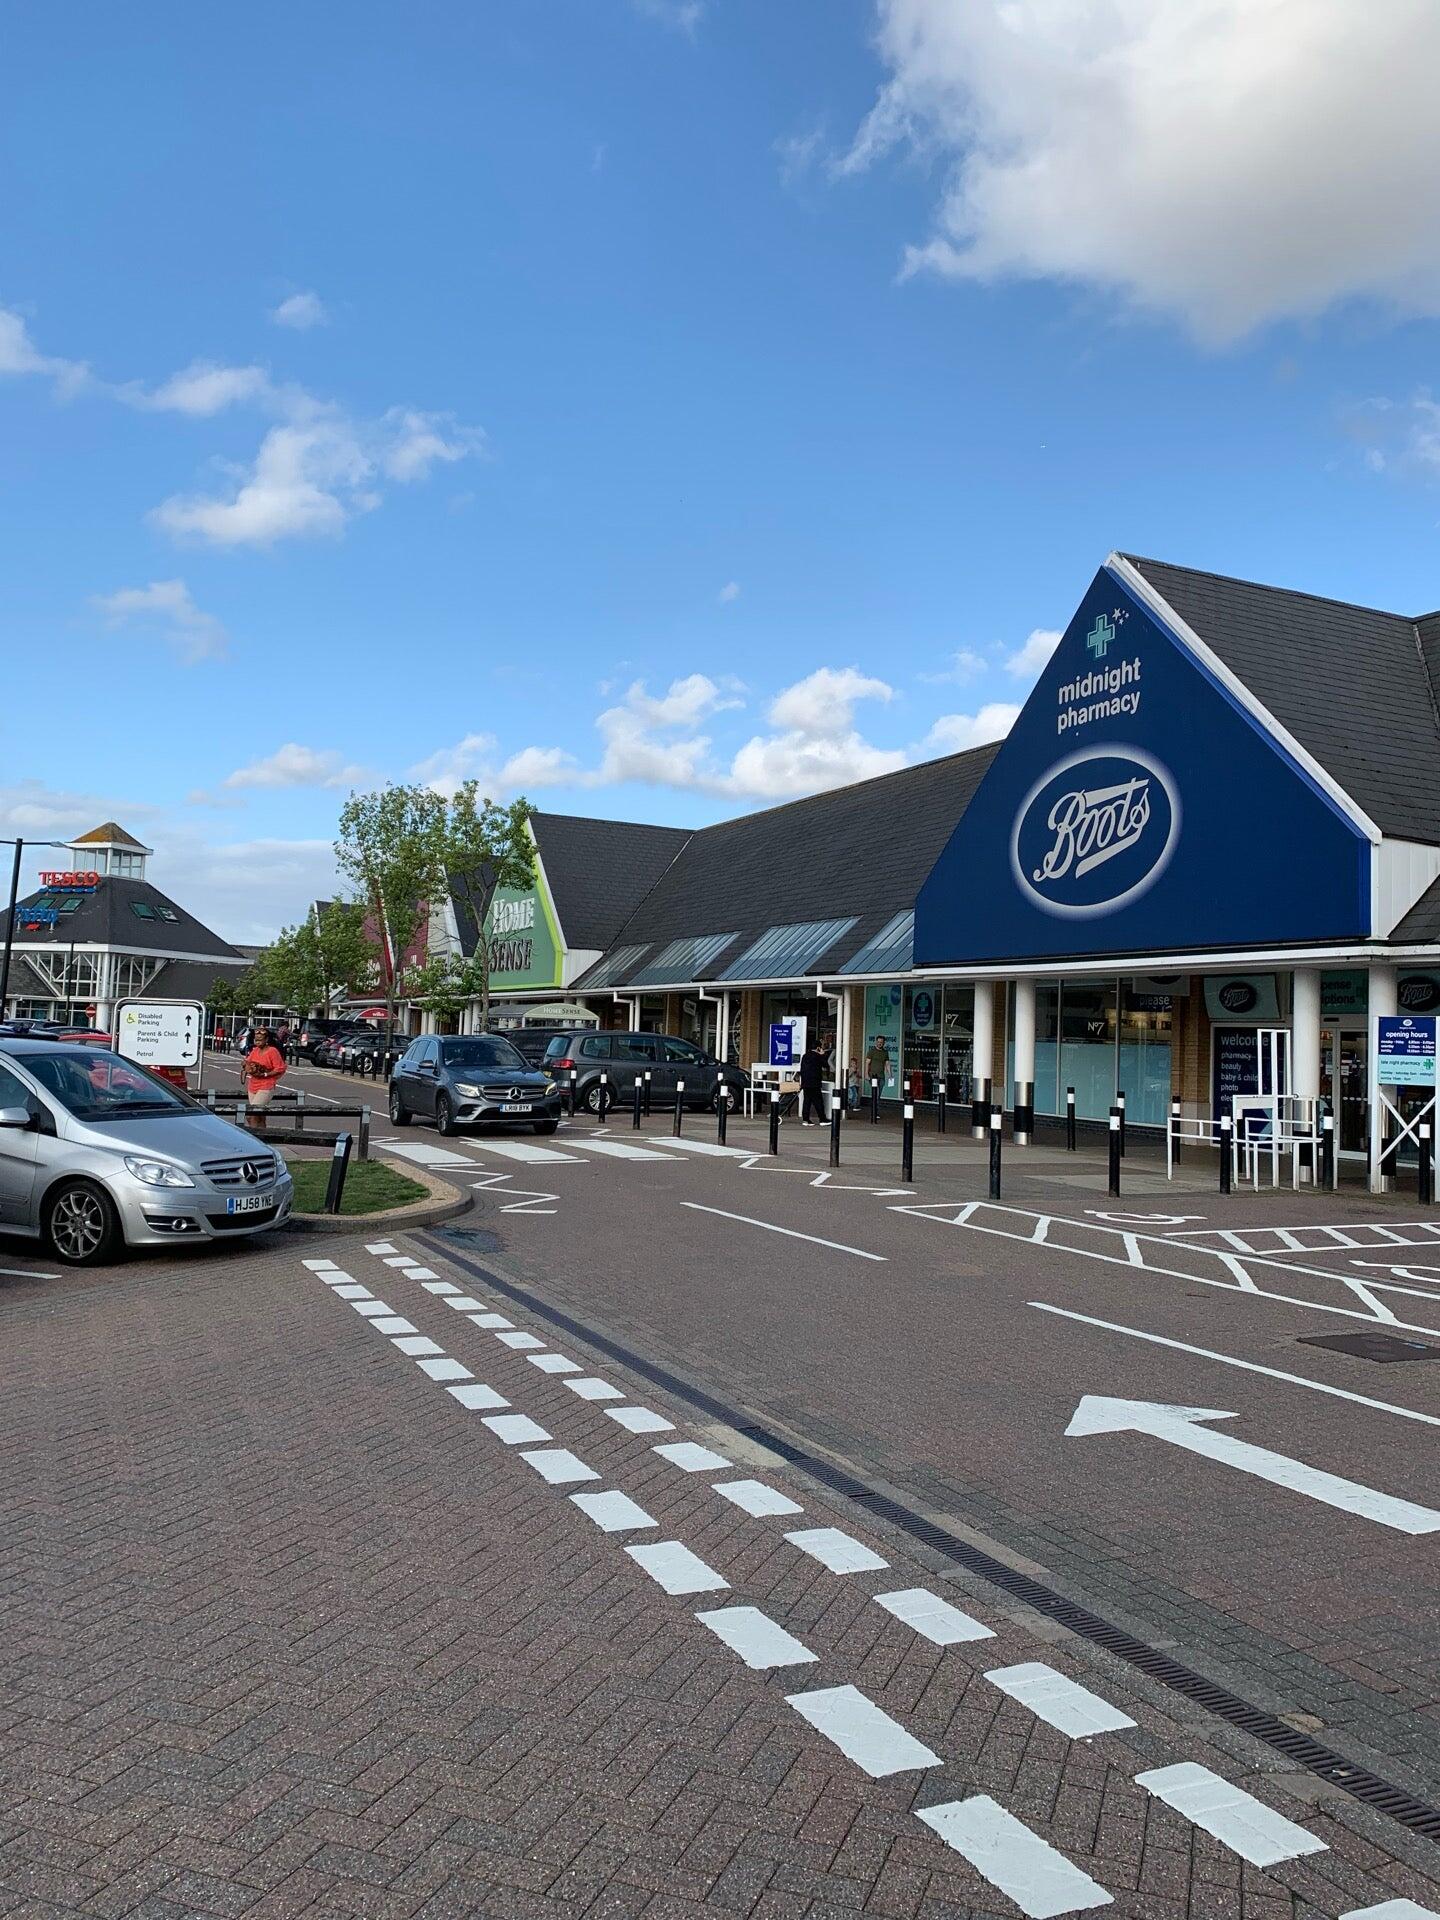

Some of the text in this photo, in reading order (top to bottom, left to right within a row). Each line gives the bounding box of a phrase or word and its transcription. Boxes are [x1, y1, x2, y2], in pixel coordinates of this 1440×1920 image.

[1058, 657, 1142, 705] midnight
[1057, 690, 1141, 735] pharmacy
[1033, 776, 1151, 883] Boots
[38, 871, 100, 887] TESCO
[492, 897, 535, 935] HOME
[489, 938, 533, 973] SENSE
[1223, 988, 1250, 1007] Boots
[1385, 1031, 1410, 1039] opening
[1220, 1052, 1252, 1060] pharmacy
[1221, 1063, 1242, 1071] beauty
[1220, 1073, 1237, 1082] baby
[1220, 1084, 1239, 1092] photo
[1220, 1094, 1233, 1102] elec
[235, 1197, 260, 1211] HJ58
